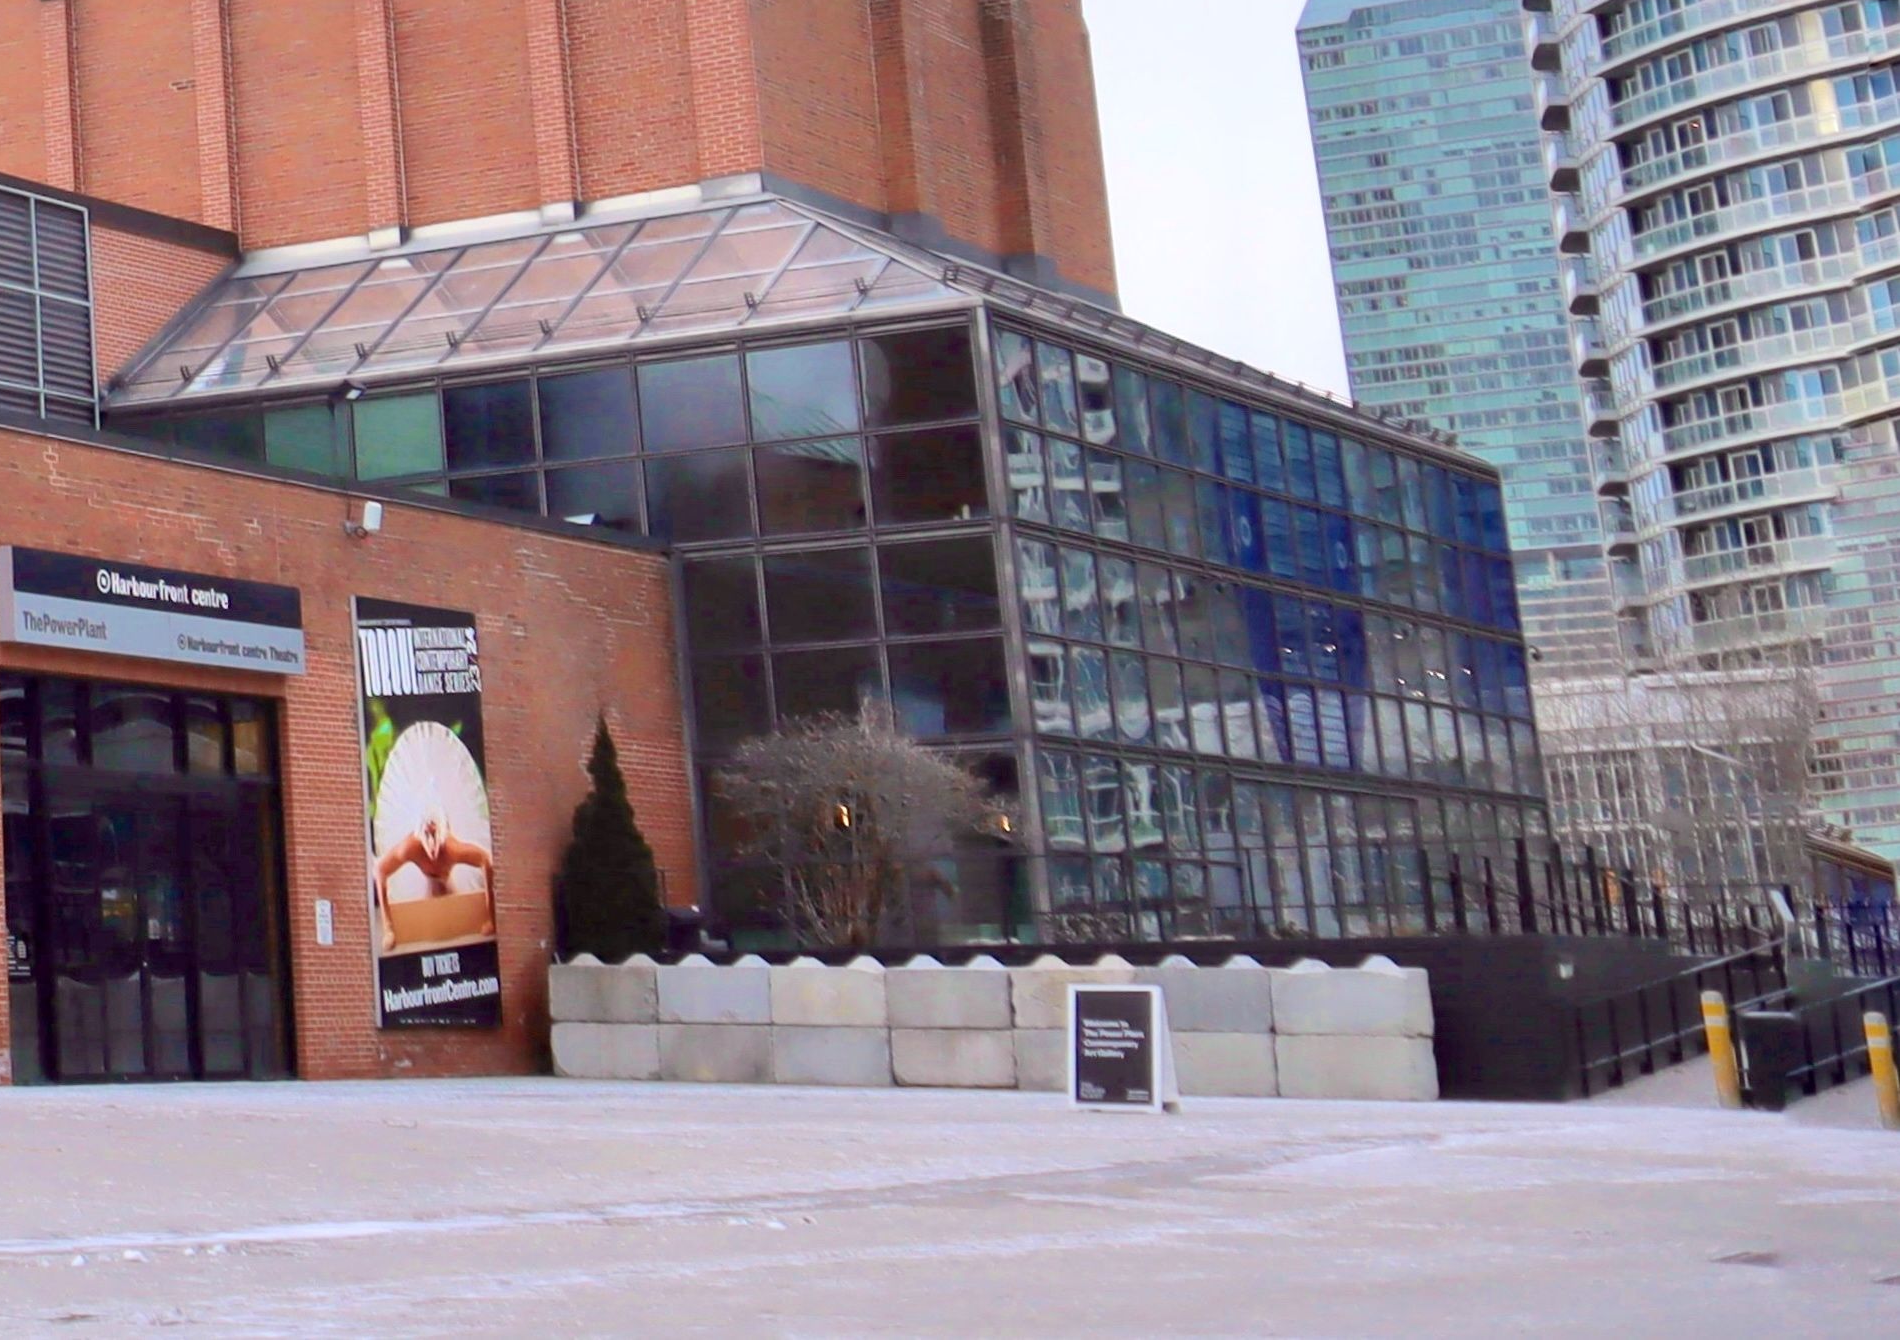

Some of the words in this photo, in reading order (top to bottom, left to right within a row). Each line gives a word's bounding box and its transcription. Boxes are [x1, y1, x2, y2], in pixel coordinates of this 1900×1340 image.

[111, 571, 188, 605] Harbourfront
[191, 588, 229, 610] centre
[23, 610, 107, 641] ThePowerPlant
[384, 977, 499, 1012] HarbourfrontCentre.com
